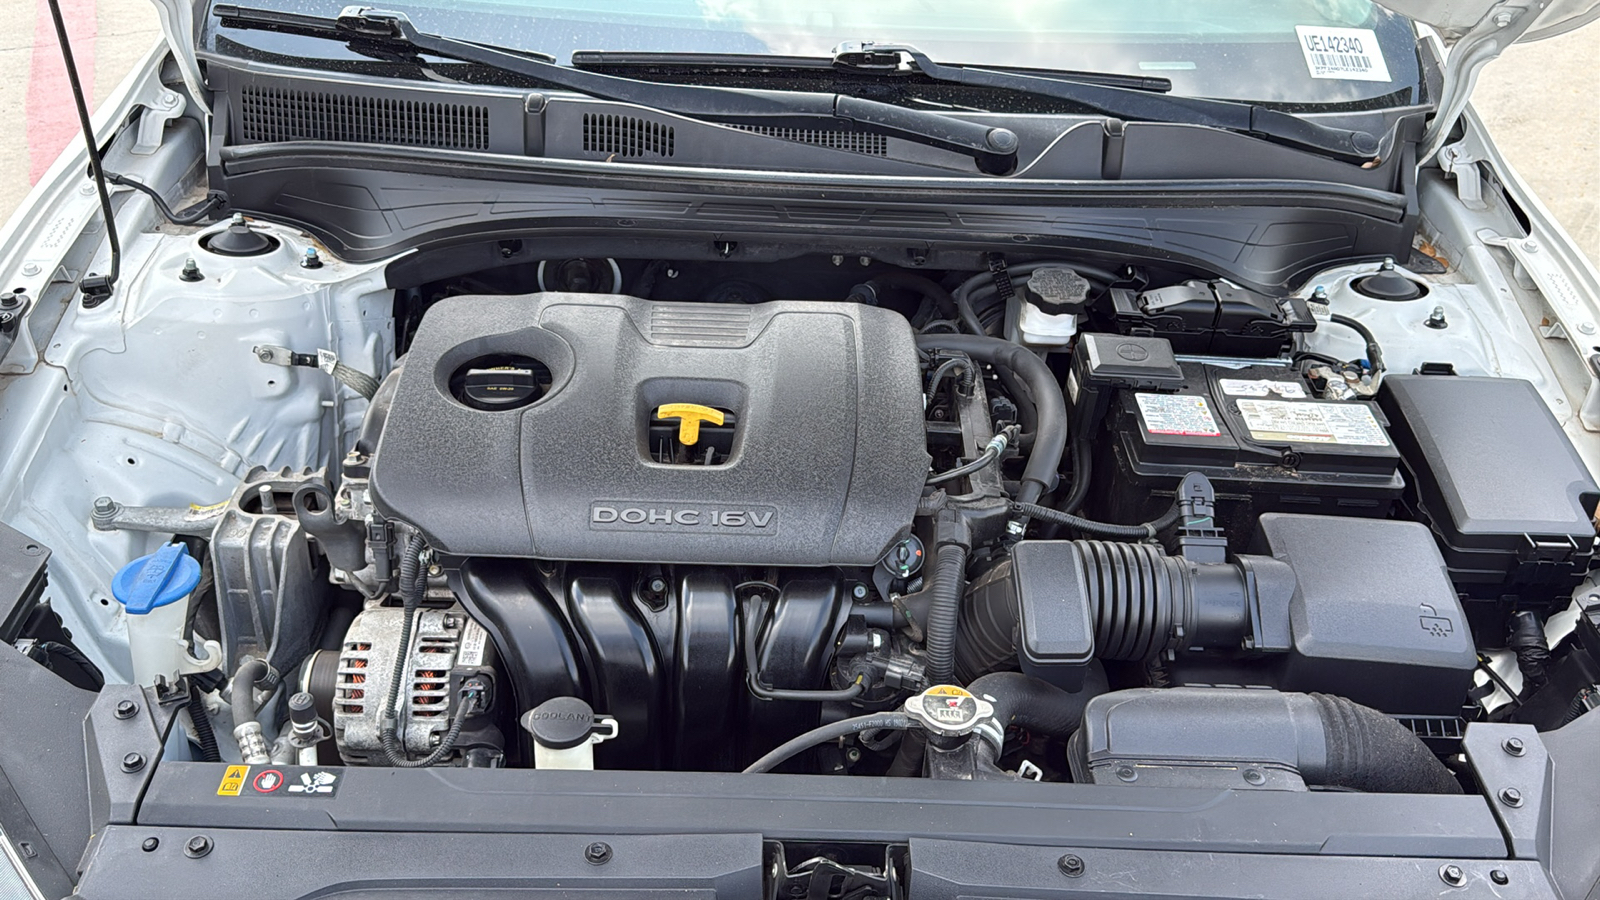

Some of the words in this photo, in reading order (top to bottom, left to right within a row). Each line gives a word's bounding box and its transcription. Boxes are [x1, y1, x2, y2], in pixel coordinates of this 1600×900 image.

[1304, 34, 1363, 54] UE142340
[593, 506, 700, 525] DOHC
[711, 510, 774, 528] 16V
[533, 712, 591, 723] COOLANT
